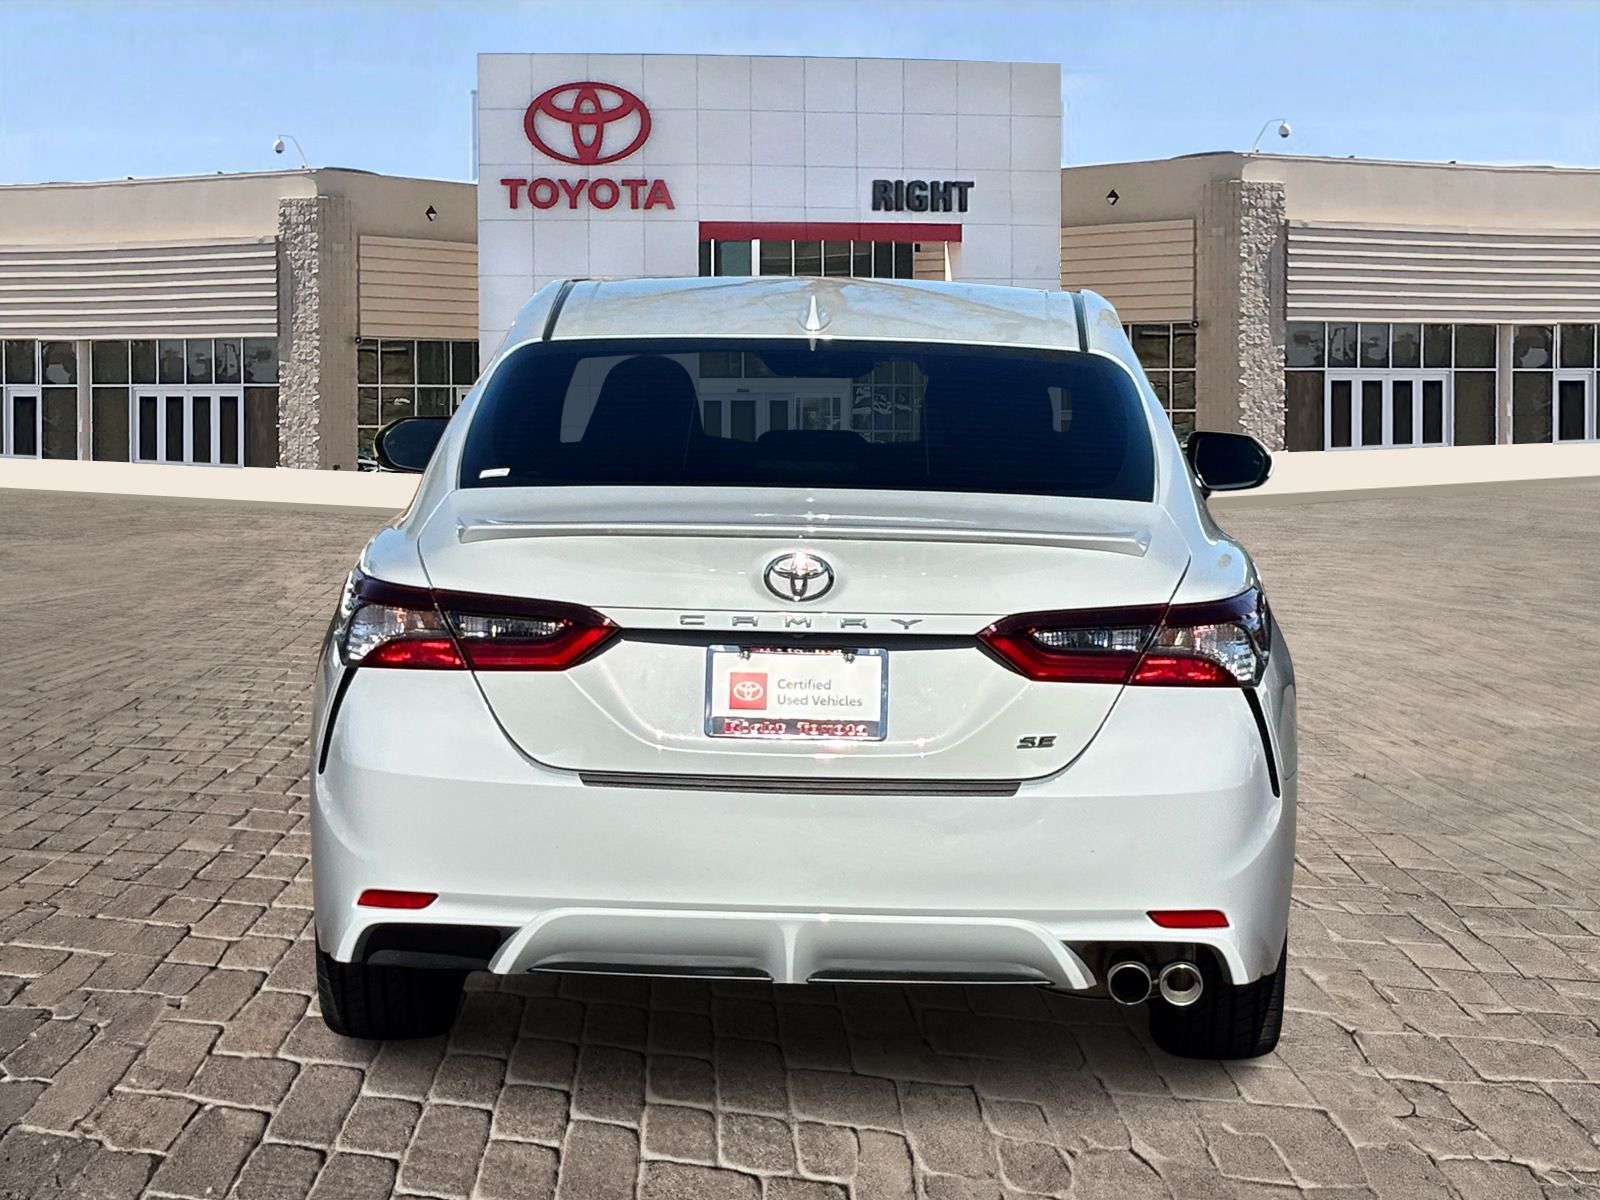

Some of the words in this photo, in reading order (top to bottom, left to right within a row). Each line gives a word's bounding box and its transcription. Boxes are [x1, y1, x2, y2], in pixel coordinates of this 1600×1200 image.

[500, 178, 675, 210] TOYOTA
[871, 179, 975, 212] RIGHT
[680, 614, 923, 630] CAMRY
[777, 678, 832, 691] Certified
[777, 694, 809, 706] Used
[812, 694, 863, 707] Vehicles
[1016, 735, 1057, 750] SE
